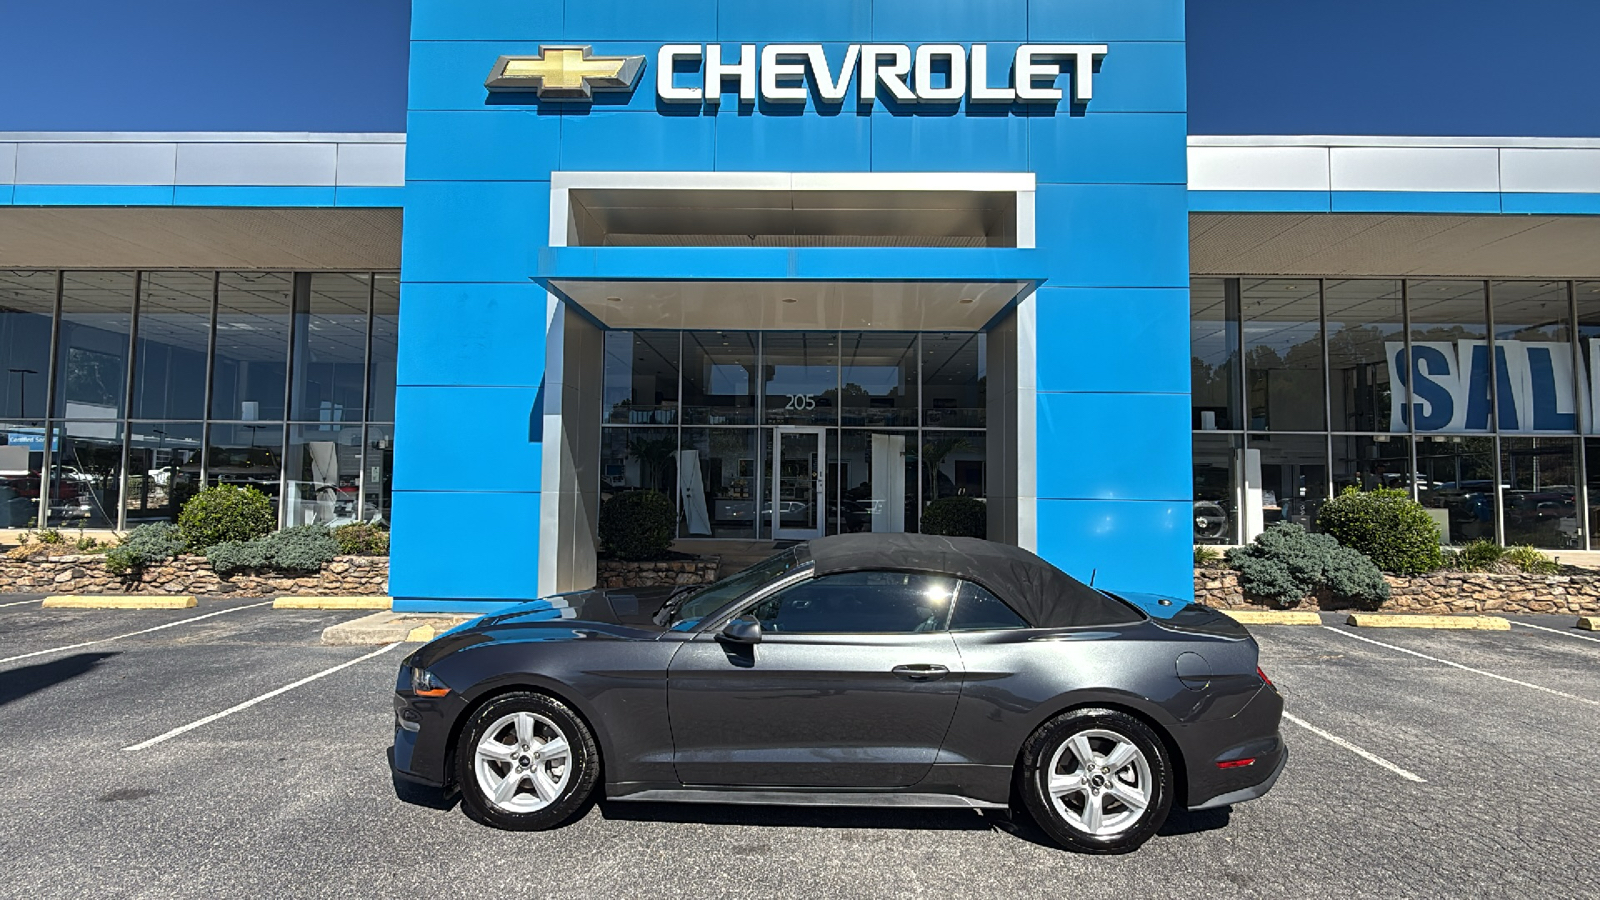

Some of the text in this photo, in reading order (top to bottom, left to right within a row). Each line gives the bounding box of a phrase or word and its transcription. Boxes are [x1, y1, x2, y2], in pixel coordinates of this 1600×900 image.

[657, 44, 1108, 103] CHEVROLET
[785, 394, 816, 410] 205
[1395, 345, 1600, 430] SAL
